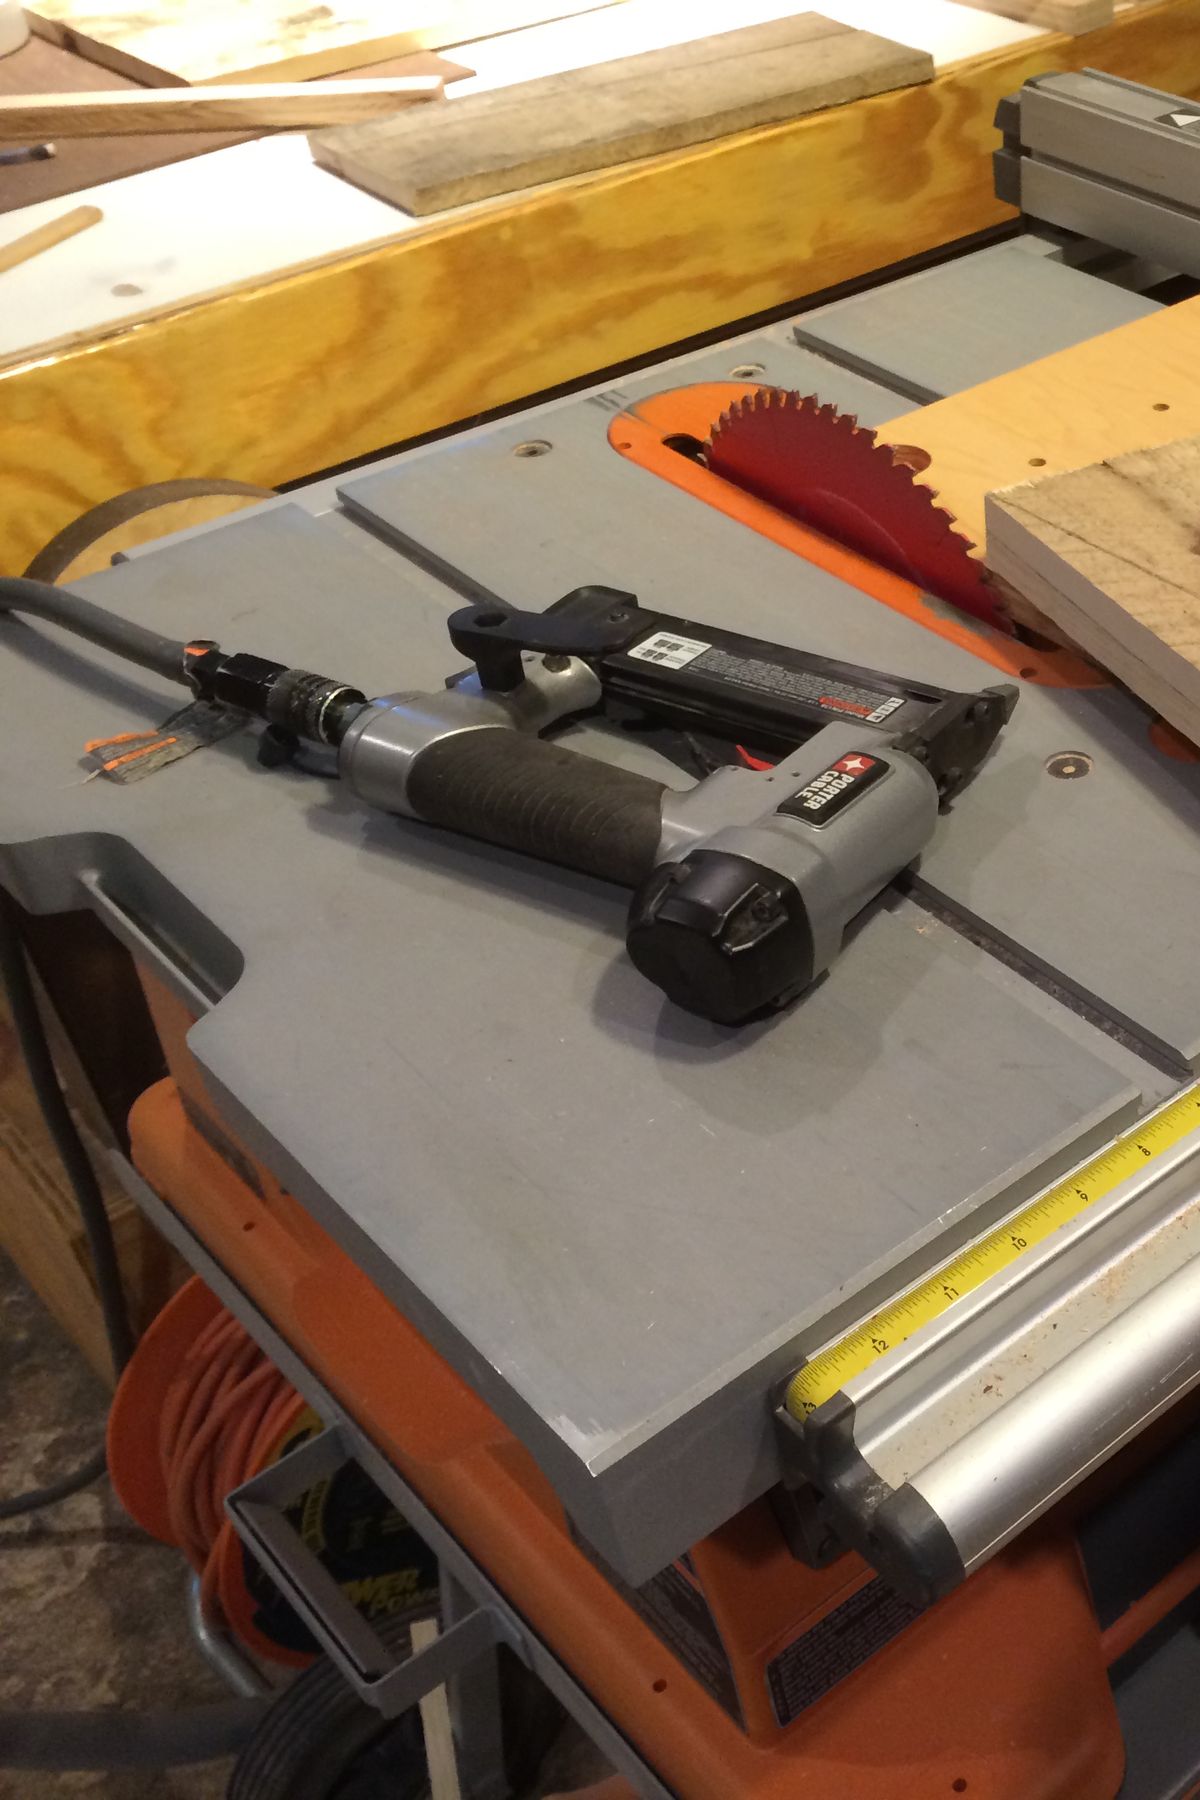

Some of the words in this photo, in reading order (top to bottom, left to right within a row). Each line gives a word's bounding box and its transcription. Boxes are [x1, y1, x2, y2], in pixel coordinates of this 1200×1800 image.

[795, 770, 840, 799] CABLE
[803, 773, 855, 810] PORTER
[1141, 1147, 1151, 1157] 8
[1012, 1238, 1028, 1251] 10
[944, 1287, 960, 1301] 11
[872, 1340, 889, 1354] 12
